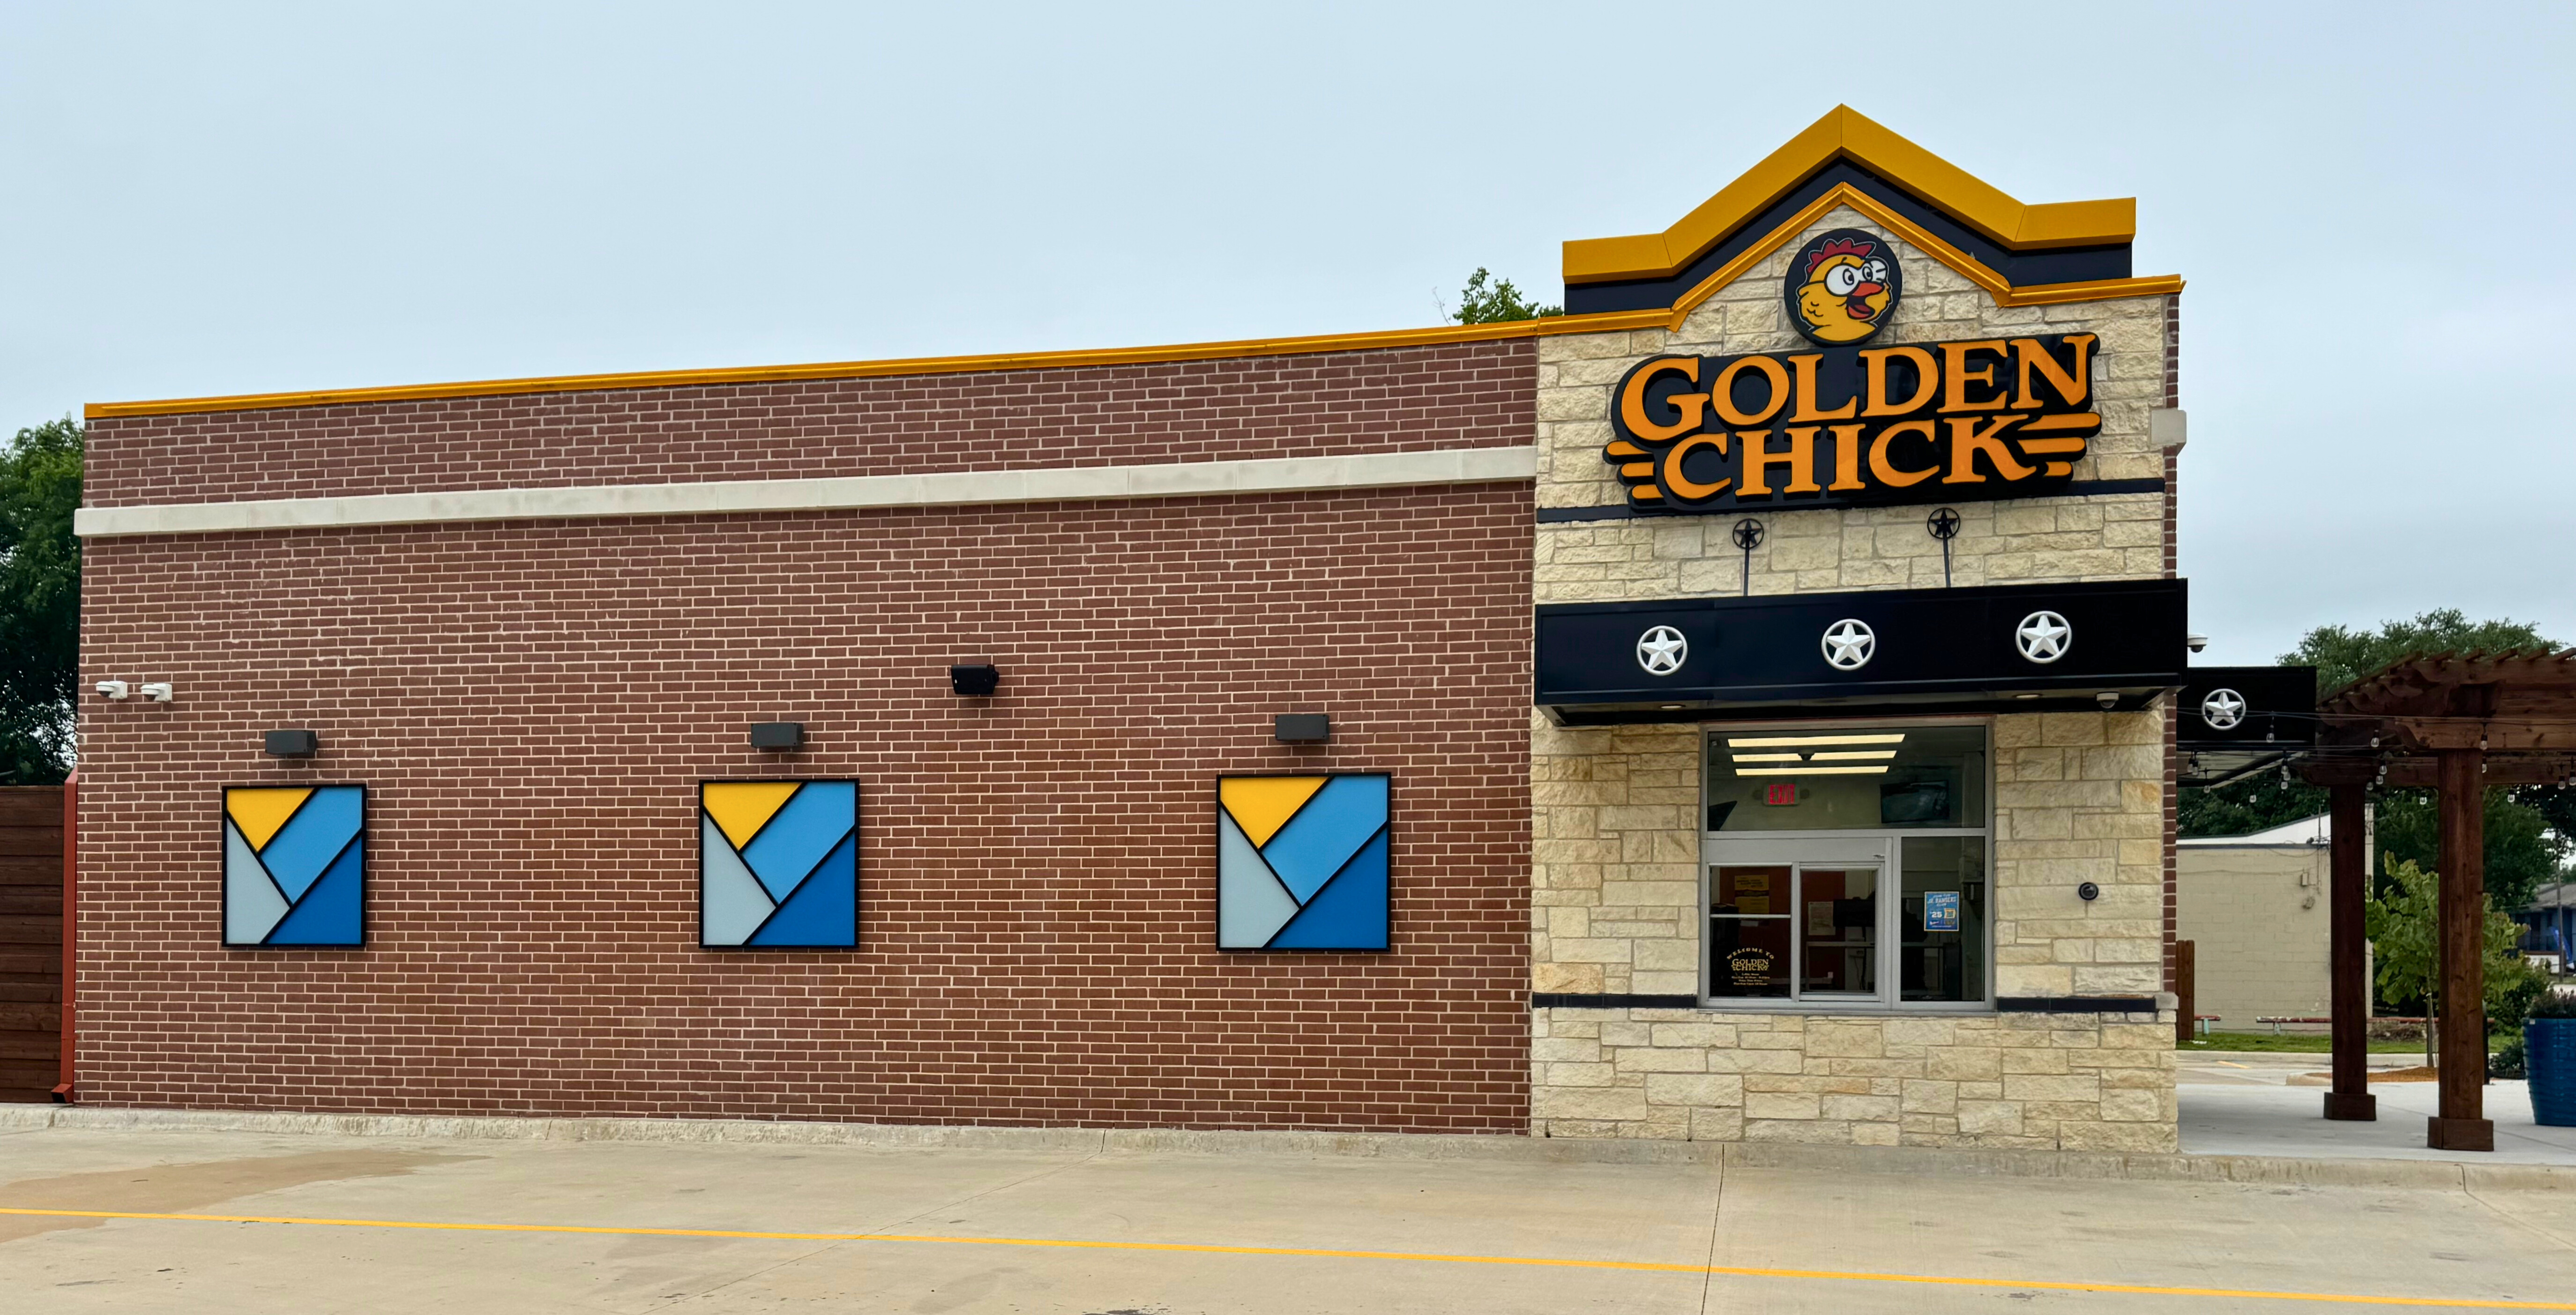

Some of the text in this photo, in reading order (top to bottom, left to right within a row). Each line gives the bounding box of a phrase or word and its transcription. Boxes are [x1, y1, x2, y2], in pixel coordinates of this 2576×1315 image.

[1621, 335, 2095, 440] GOLDEN
[1664, 414, 2036, 498] CHICK
[1769, 784, 1795, 805] EXIT
[1727, 948, 1762, 959] WELCOME
